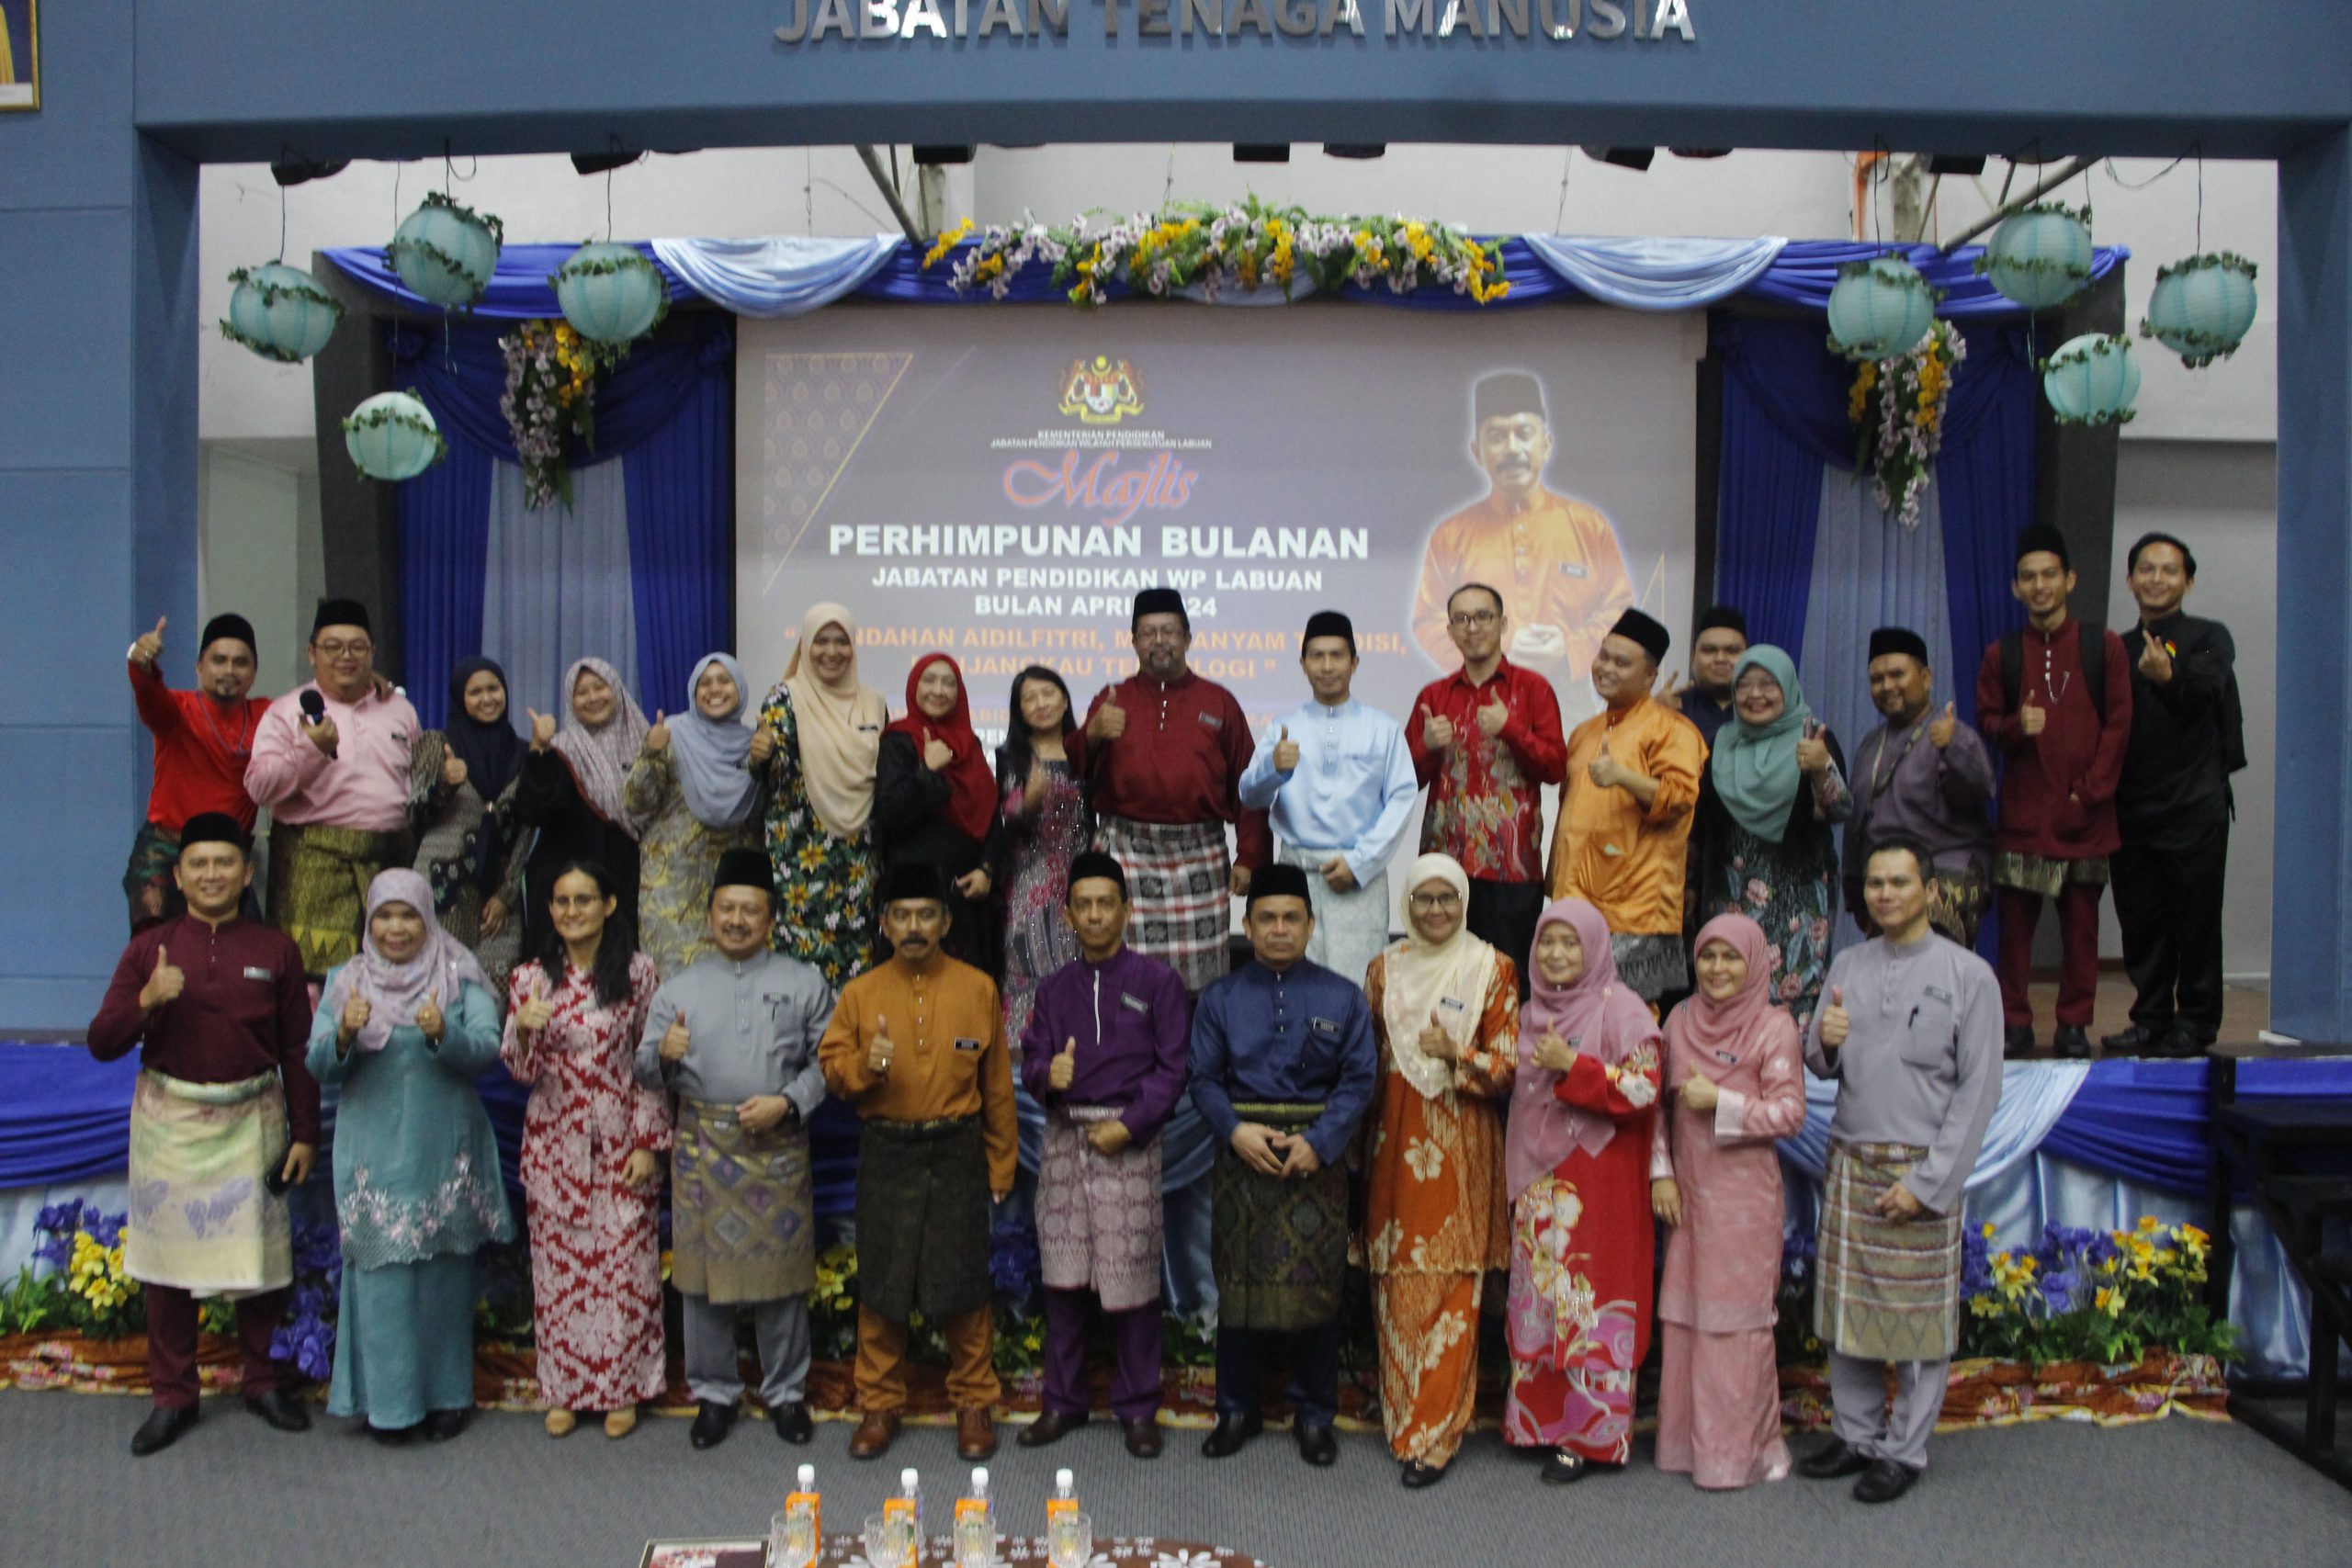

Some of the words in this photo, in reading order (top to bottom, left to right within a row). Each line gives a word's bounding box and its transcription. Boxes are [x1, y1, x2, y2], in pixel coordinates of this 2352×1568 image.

[775, 0, 1069, 41] JABATAN
[1104, 0, 1365, 38] TENAGA
[1385, 0, 1696, 40] MANUSIA
[1003, 449, 1198, 525] Majlis
[830, 524, 1142, 557] PERHIMPUNAN
[1161, 526, 1369, 559] BULANAN
[871, 566, 989, 588] JABATAN
[996, 568, 1159, 589] PENDIDIKAN
[1167, 569, 1207, 590] WP
[1216, 570, 1323, 591] LABUAN
[974, 594, 1063, 616] BULAN
[1069, 595, 1134, 617] APRI
[963, 627, 1104, 651] AIDILFITRI,
